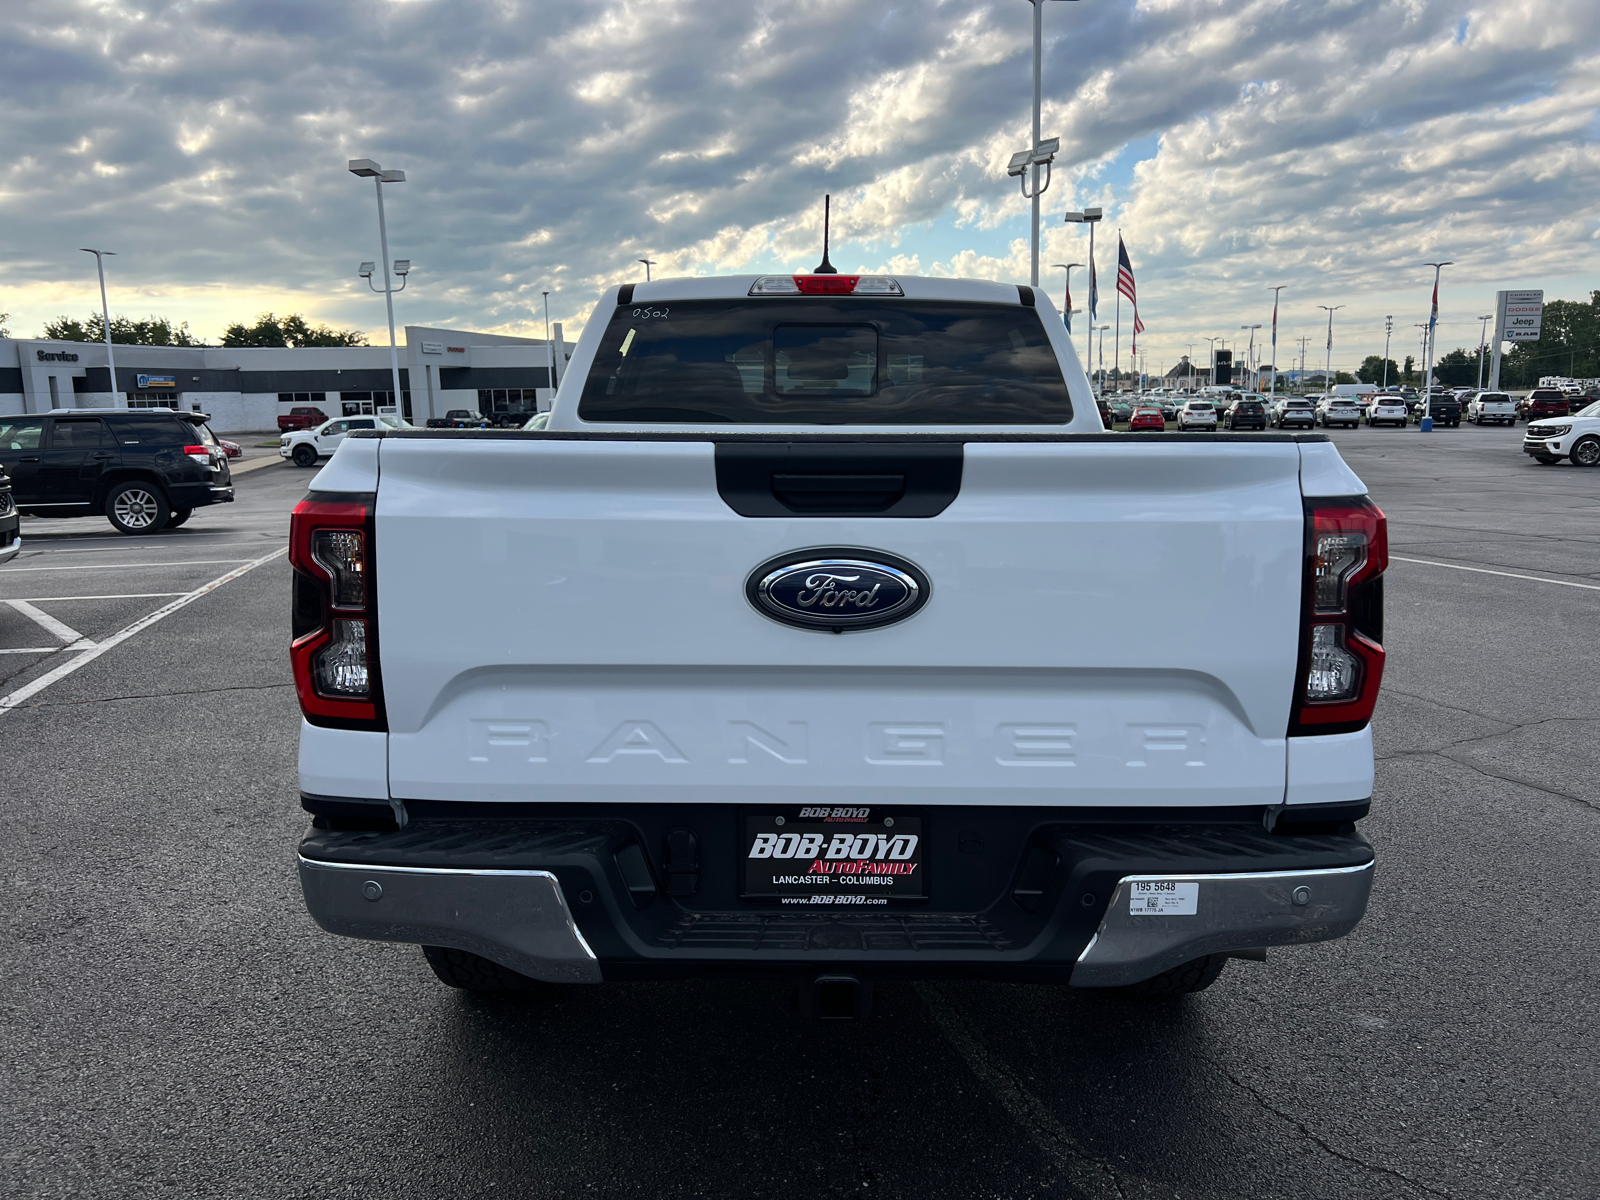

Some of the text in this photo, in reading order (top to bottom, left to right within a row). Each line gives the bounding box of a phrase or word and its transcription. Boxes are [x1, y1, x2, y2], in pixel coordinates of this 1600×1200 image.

[632, 306, 670, 319] 0502
[1512, 317, 1534, 326] Jeep
[37, 350, 79, 362] Service
[797, 573, 881, 608] Ford
[468, 718, 1206, 767] RANGER
[799, 807, 870, 818] BOB-BOYD
[748, 833, 919, 860] BOB-BOYD
[773, 876, 830, 884] LANCASTER
[840, 876, 894, 885] COLUMBUS
[1135, 882, 1176, 891] 195 5648
